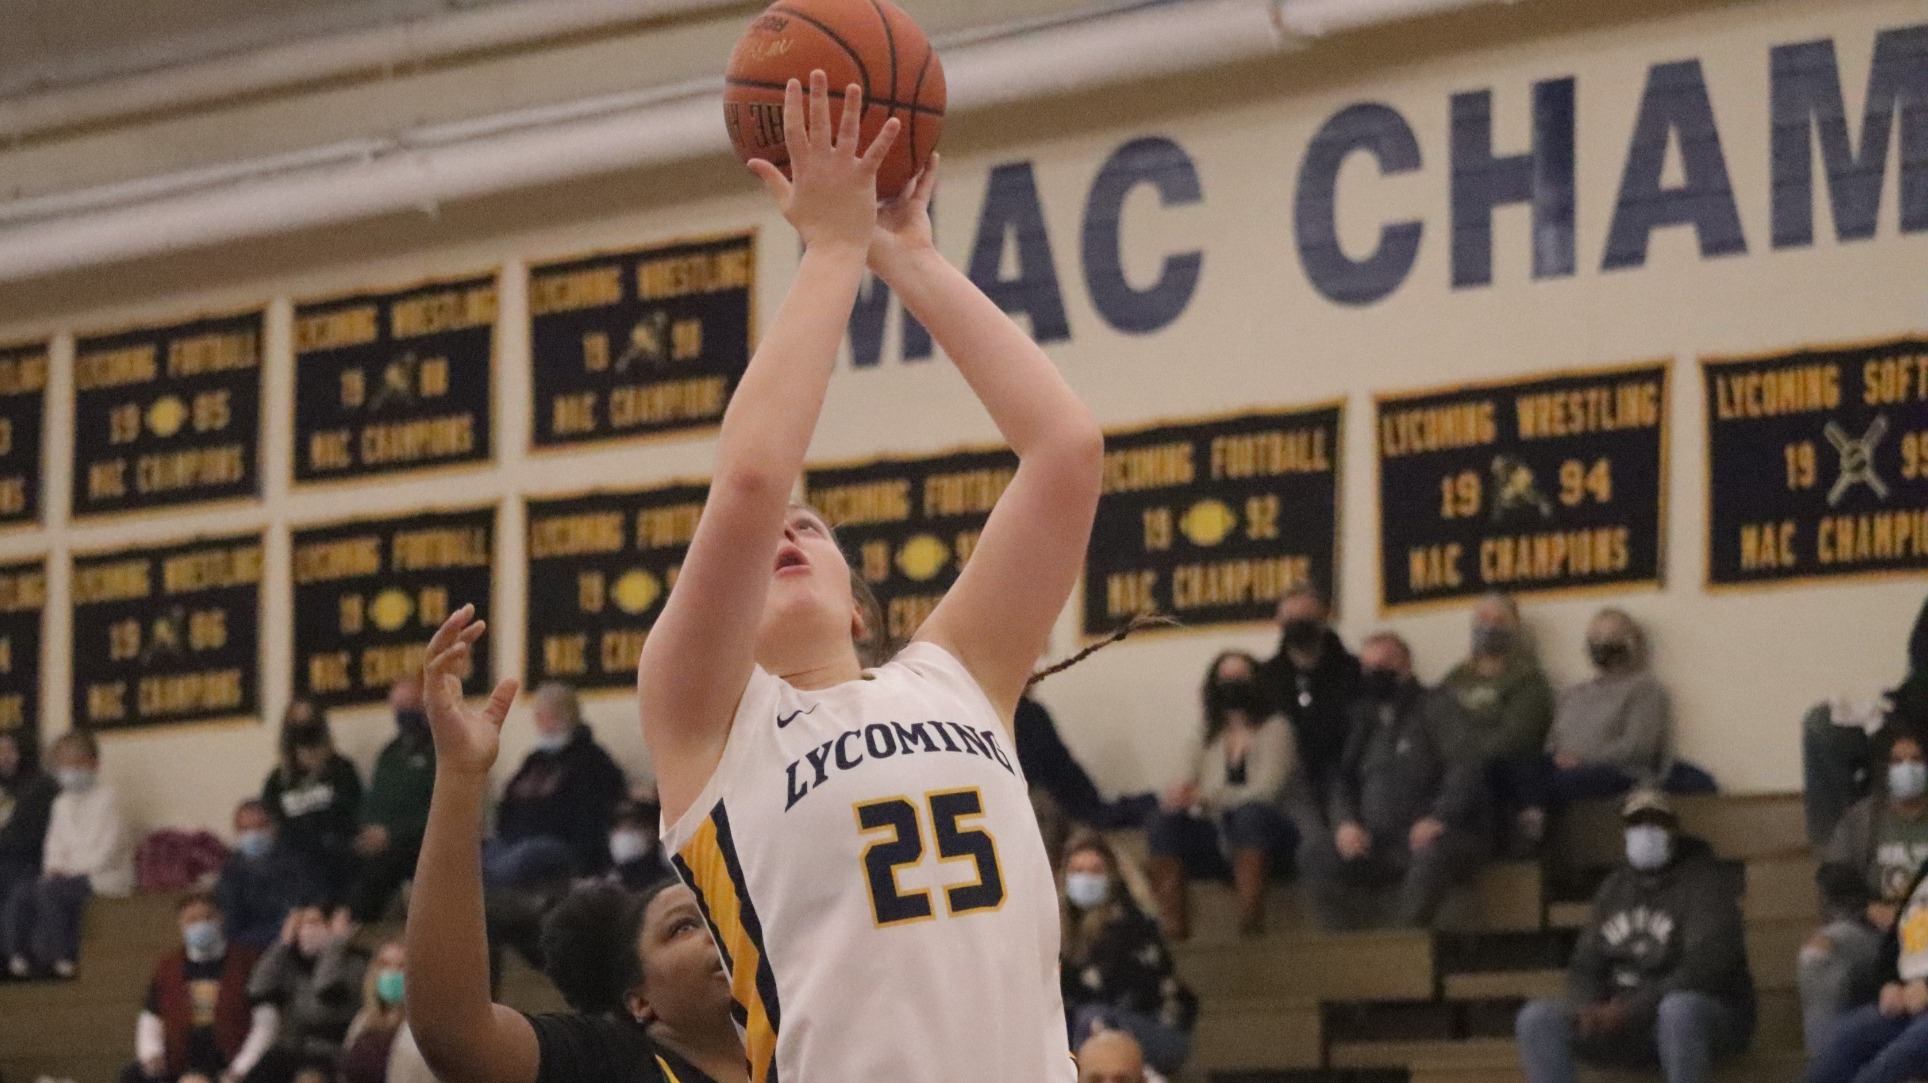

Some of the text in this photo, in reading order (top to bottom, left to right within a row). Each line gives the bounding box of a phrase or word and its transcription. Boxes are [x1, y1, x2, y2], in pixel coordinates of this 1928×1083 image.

[1292, 24, 1928, 310] CHAM
[1516, 383, 1656, 440] WRESTLING
[1717, 365, 1841, 419] LYCOMING
[1441, 458, 1612, 518] 19 94
[1785, 441, 1816, 490] 19
[1410, 527, 1629, 591] MAC CHAMPIONS
[1740, 520, 1797, 570] MAC
[784, 720, 1015, 813] LYCOMING
[851, 785, 1008, 929] 25
